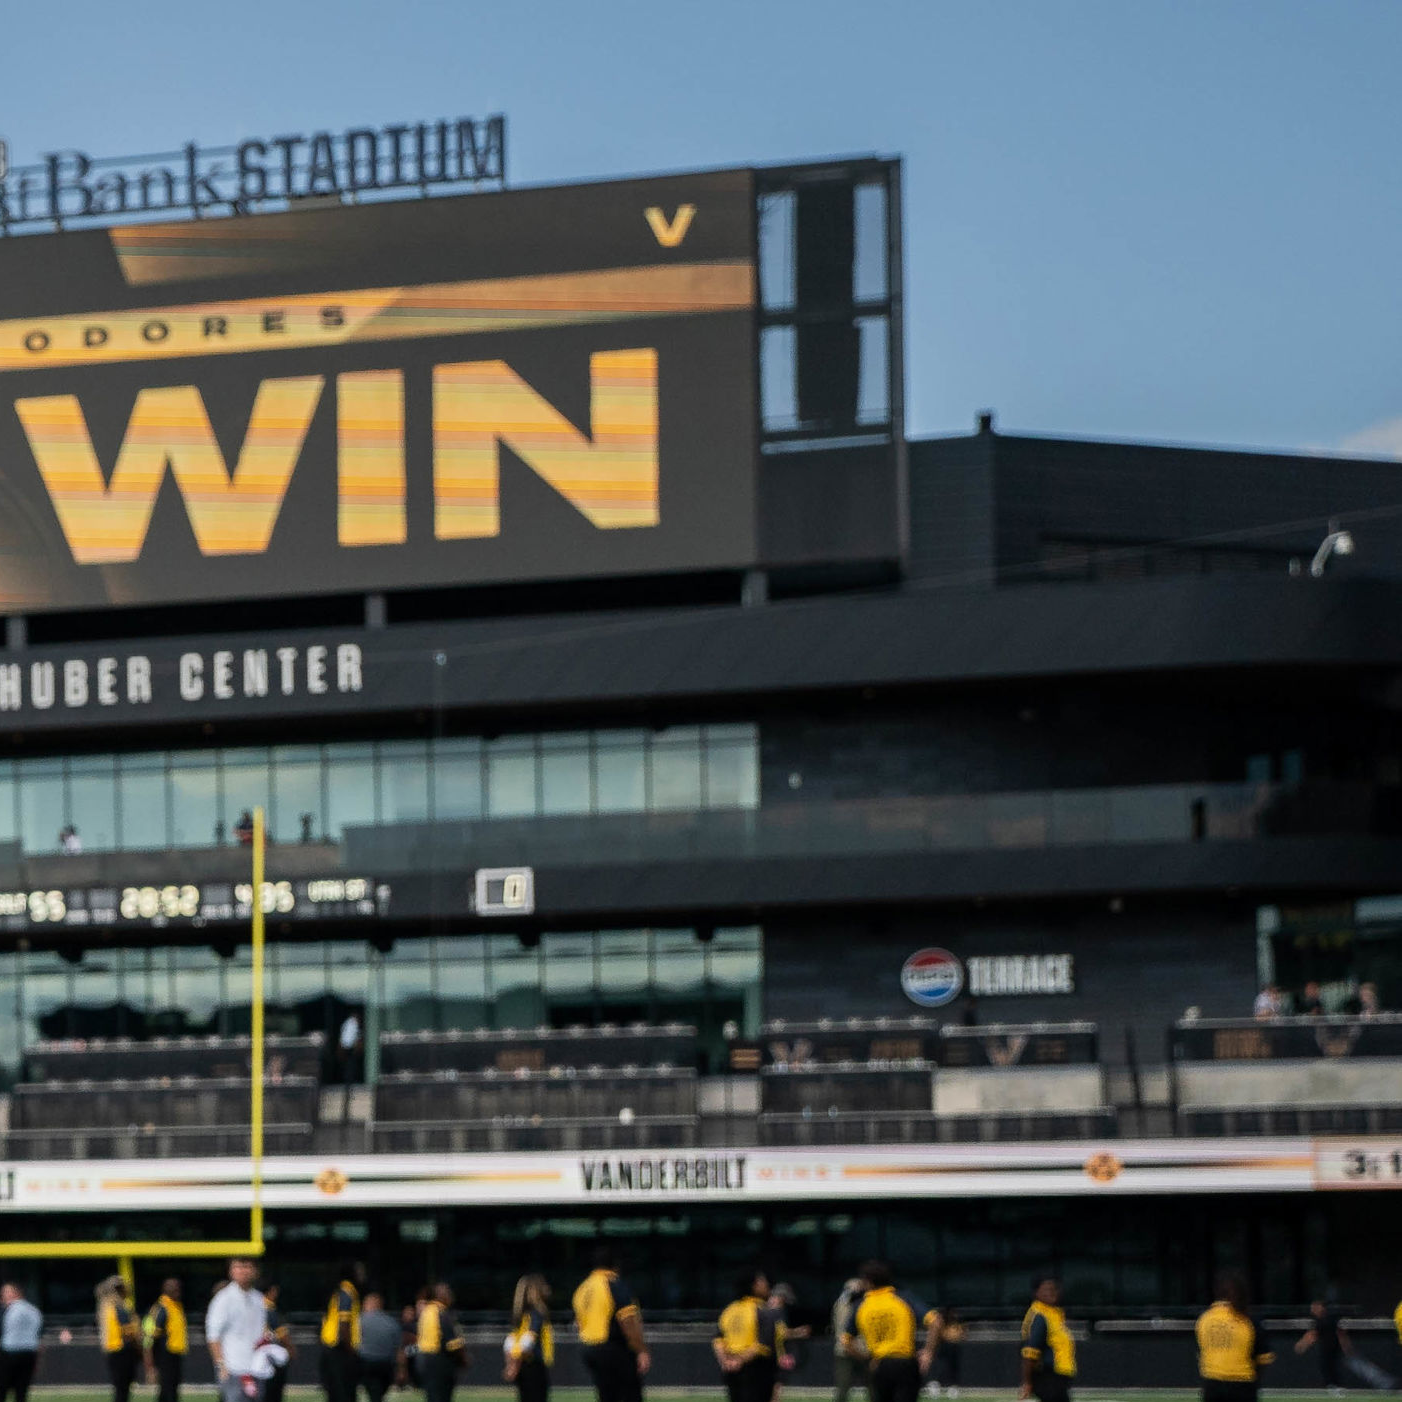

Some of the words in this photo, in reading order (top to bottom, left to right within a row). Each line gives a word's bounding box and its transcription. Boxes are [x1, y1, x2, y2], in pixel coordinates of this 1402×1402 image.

[236, 113, 506, 200] STADIUM
[643, 203, 697, 248] V
[14, 347, 660, 565] WIN
[179, 643, 363, 701] CENTER
[966, 953, 1075, 996] TERRACE
[581, 1154, 746, 1190] VANDERBILT
